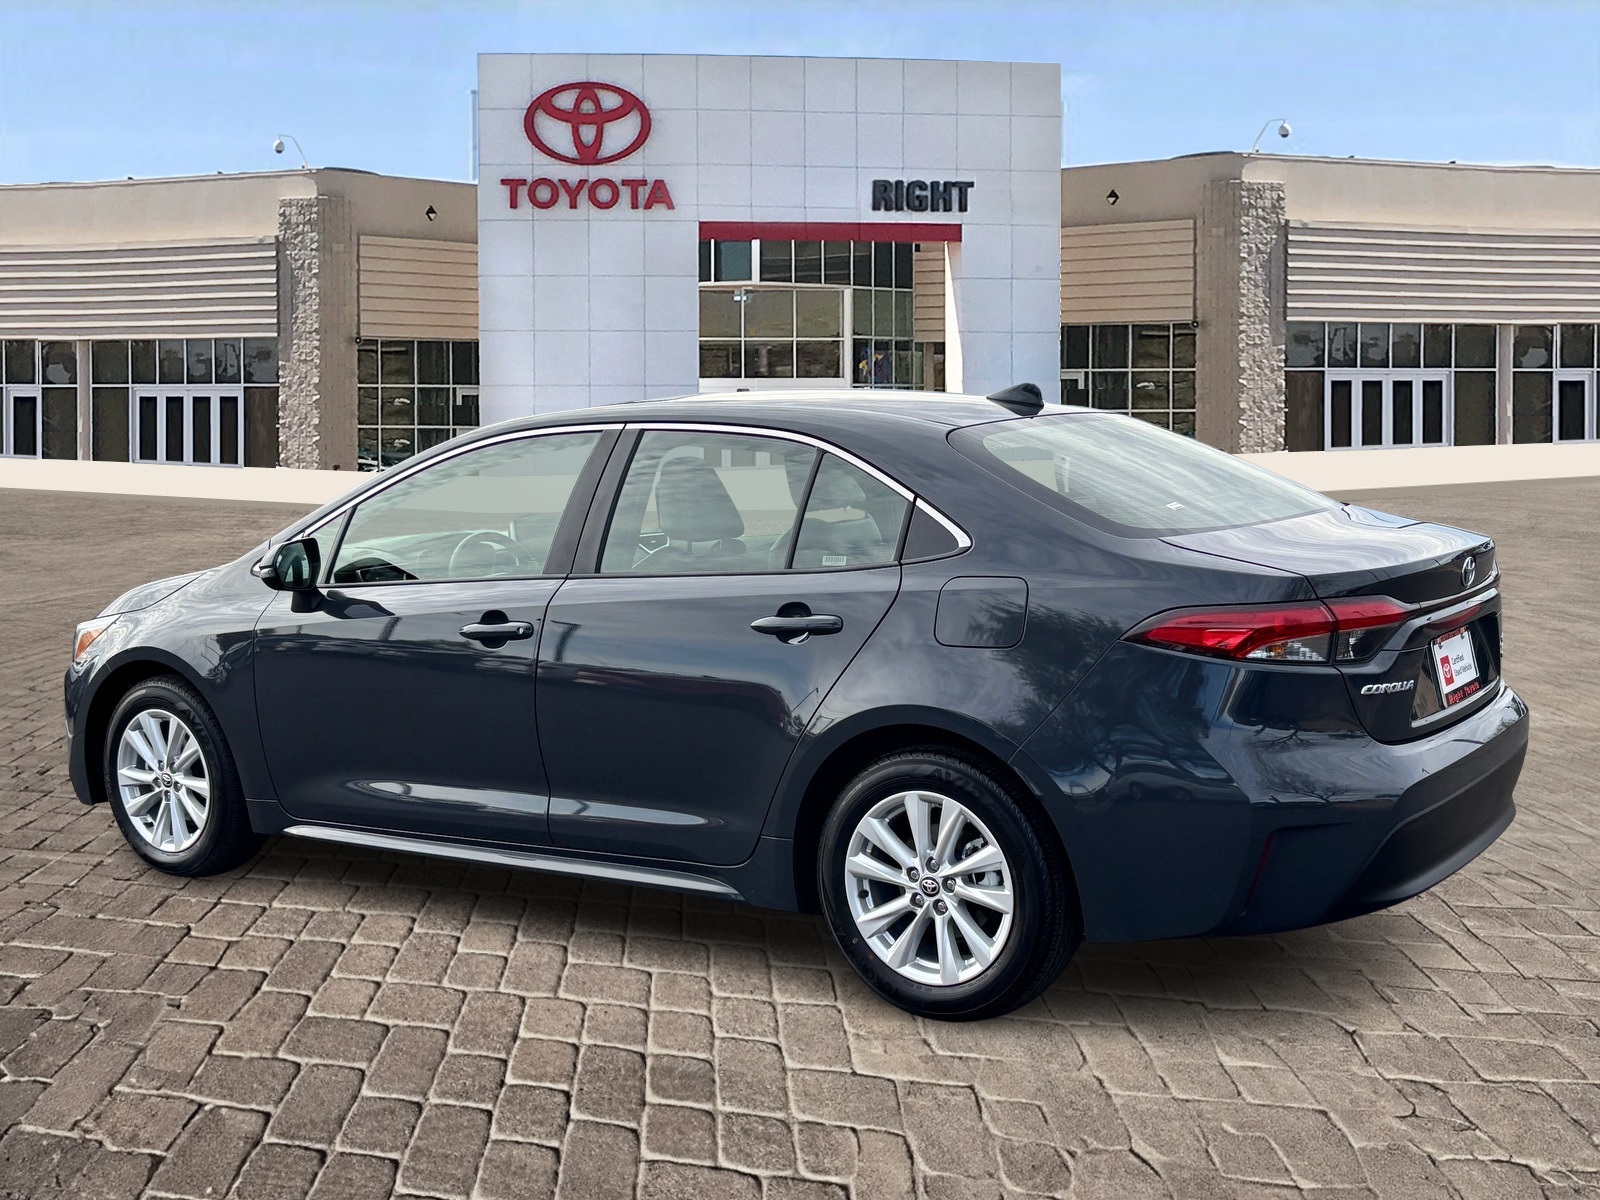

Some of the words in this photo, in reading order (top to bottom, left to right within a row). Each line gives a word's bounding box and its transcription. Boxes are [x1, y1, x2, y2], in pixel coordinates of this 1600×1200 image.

[501, 178, 675, 210] TOYOTA
[871, 179, 975, 213] RIGHT
[1361, 679, 1415, 695] COROLLA
[1448, 689, 1464, 705] Right
[1464, 681, 1480, 697] Toyota
